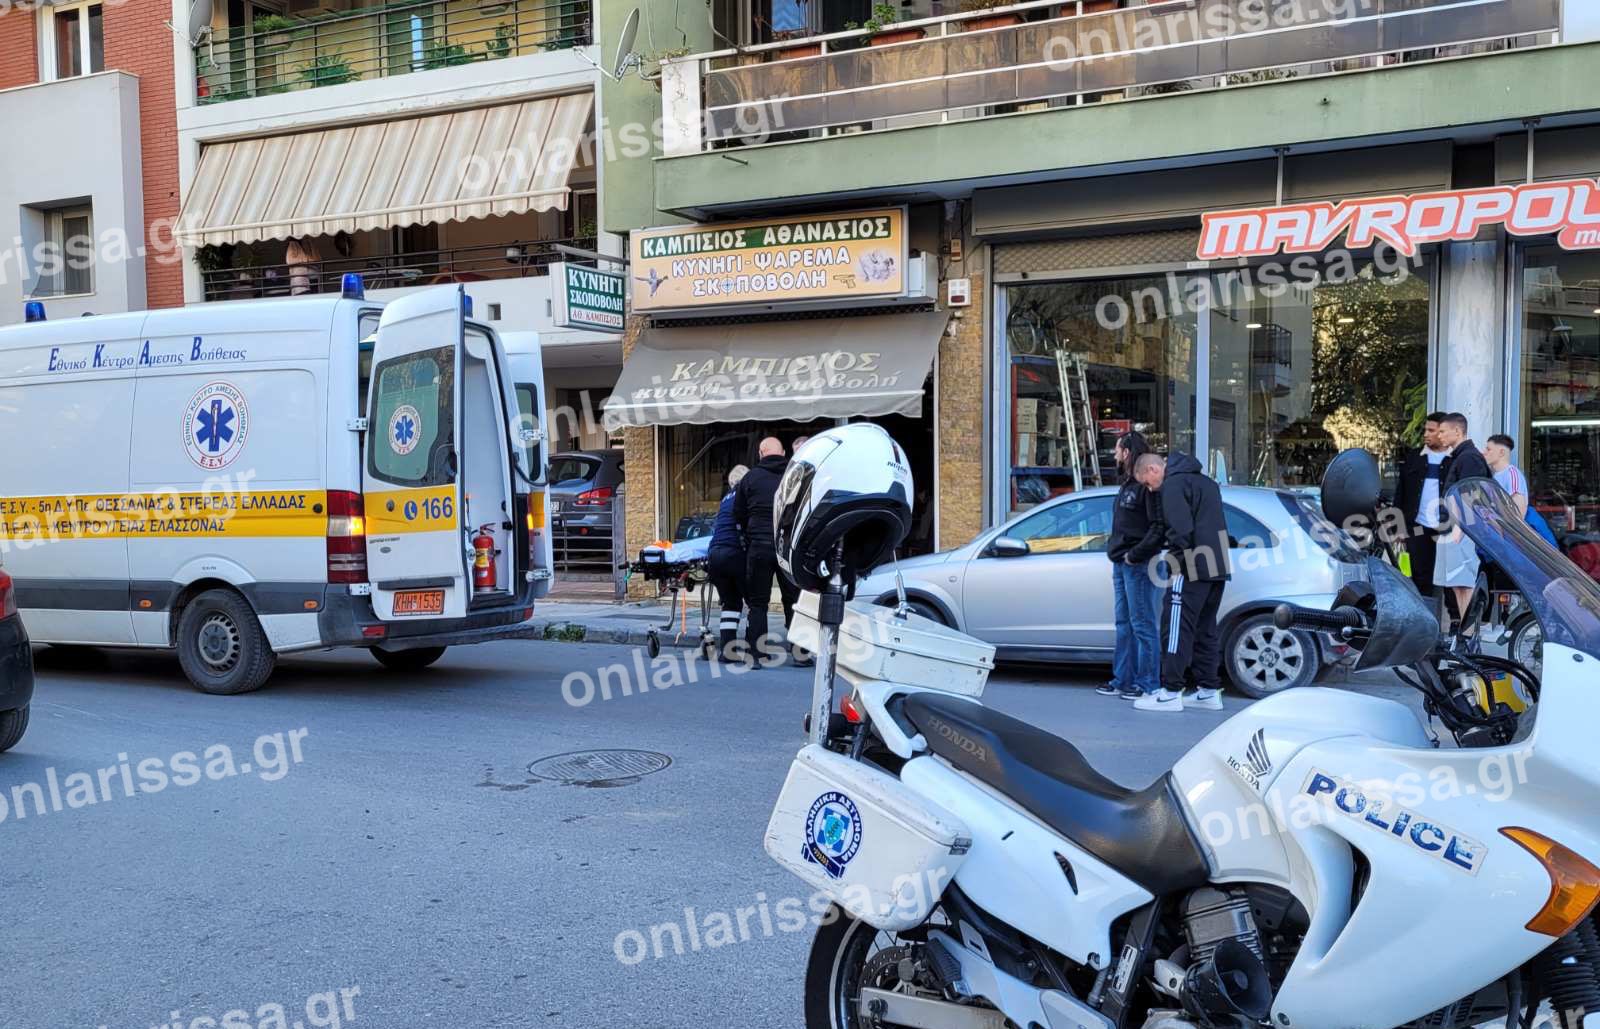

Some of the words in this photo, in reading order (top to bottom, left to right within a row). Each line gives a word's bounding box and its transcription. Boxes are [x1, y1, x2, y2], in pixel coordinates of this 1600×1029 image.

[643, 229, 747, 257] ΚΑΜΠΙΣΙΟΣ
[762, 217, 889, 246] ΑΘΑΝΑΣΙΟΣ
[569, 269, 623, 295] ΚΥΝΗΓΙ
[570, 290, 623, 311] ΣΚΟΠΟΒΟΛΗ
[669, 350, 882, 382] ΚΑΜΠΙΣΙΟΣ
[96, 497, 164, 512] ΘΕΣΣΑΛΙΑΣ
[180, 496, 237, 510] ΣΤΕΡΕΑΣ
[242, 494, 306, 510] ΕΛΛΑΔΑΣ
[421, 496, 453, 520] 166
[150, 518, 226, 532] ΕΛΑΣΣΟΝΑΣ
[928, 715, 987, 762] HONDA
[806, 793, 837, 844] ΕΛΛΗΝΙΚΗ
[838, 795, 862, 862] ΑΣΤΥΝΟΜΙΑ
[1306, 773, 1474, 870] POLICE
